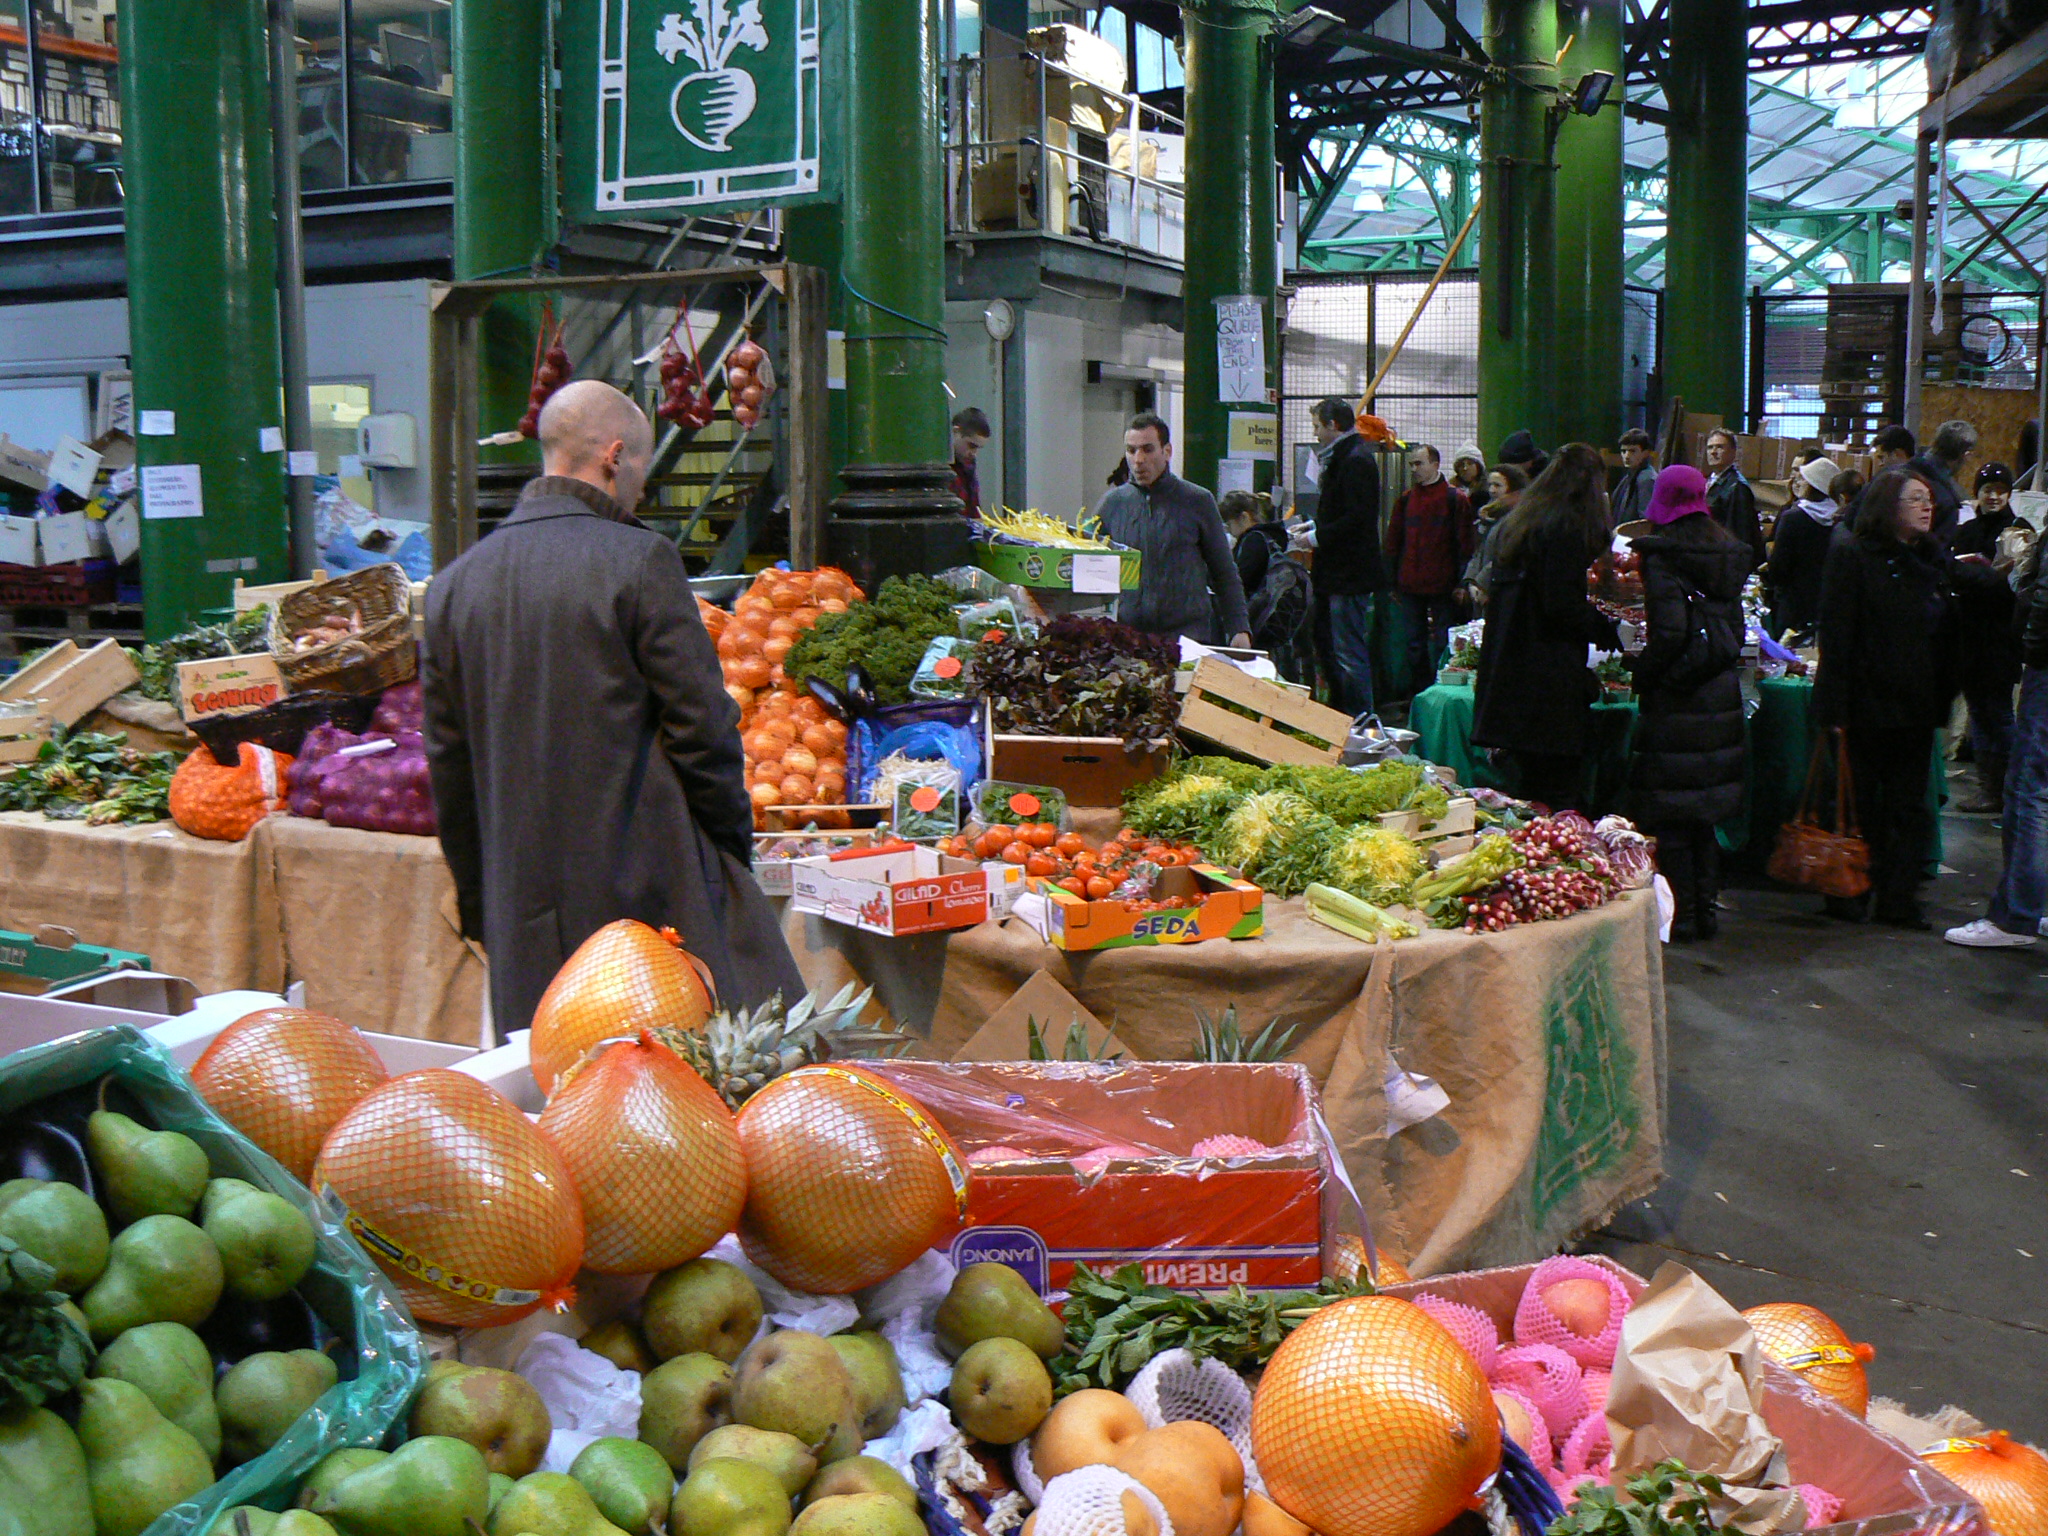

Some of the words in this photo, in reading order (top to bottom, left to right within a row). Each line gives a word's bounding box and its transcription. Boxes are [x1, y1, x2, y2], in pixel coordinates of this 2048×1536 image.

[1219, 304, 1259, 317] PLEASE
[1217, 318, 1261, 334] QUEUE
[895, 884, 942, 901] GILAD
[950, 880, 982, 895] Cherry
[1132, 915, 1201, 939] SEDA
[963, 1246, 1035, 1262] JIANONG
[1092, 1262, 1249, 1285] PREMI
